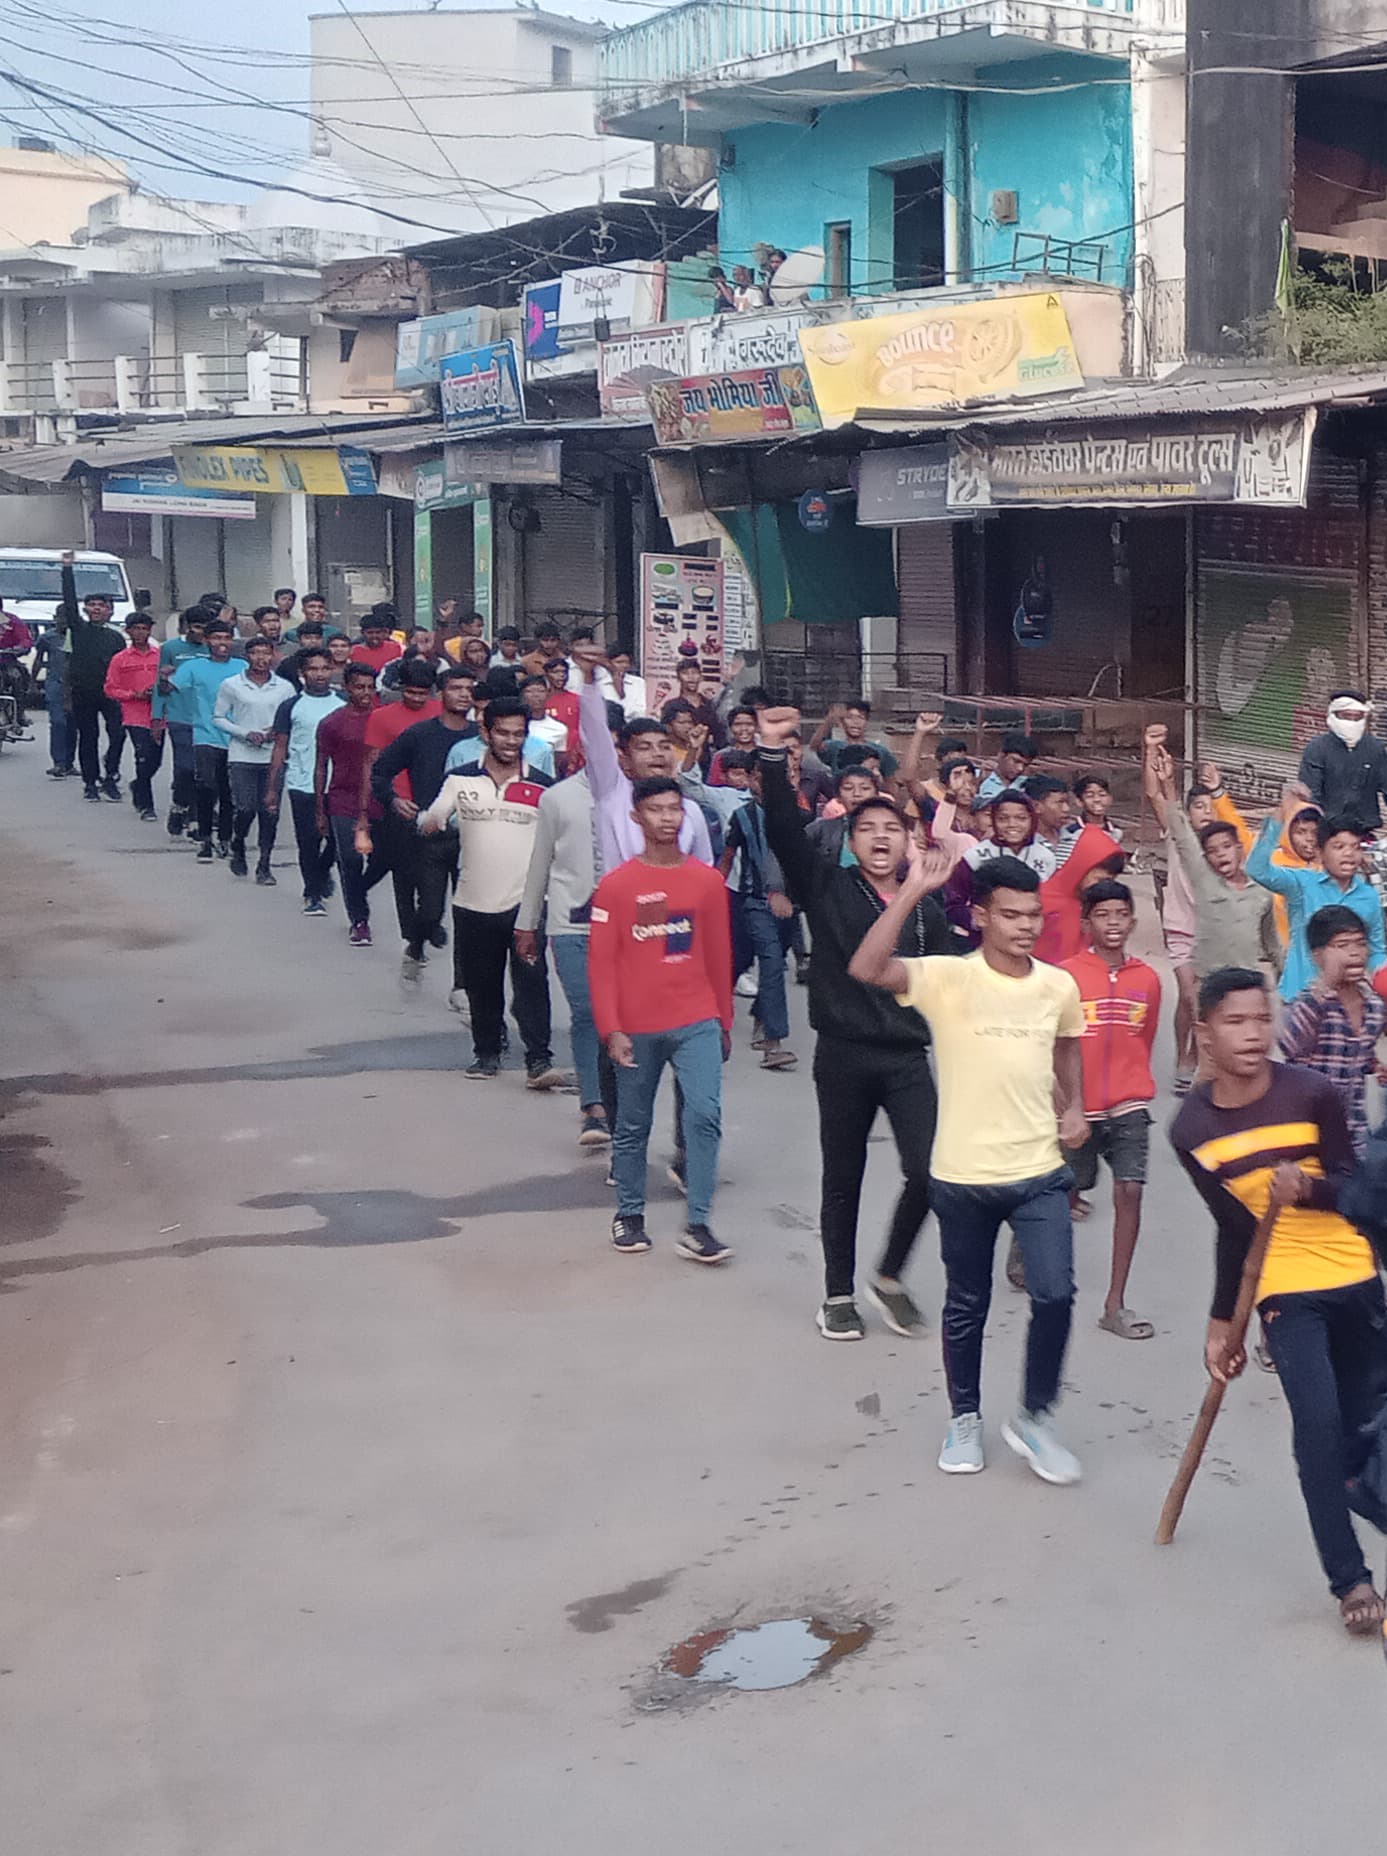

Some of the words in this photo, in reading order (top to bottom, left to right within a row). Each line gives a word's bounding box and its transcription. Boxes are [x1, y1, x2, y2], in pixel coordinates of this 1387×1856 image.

[583, 273, 622, 293] ANCHOR
[679, 387, 708, 414] जय
[1151, 434, 1197, 473] पावर
[1197, 433, 1237, 486] टूल्स
